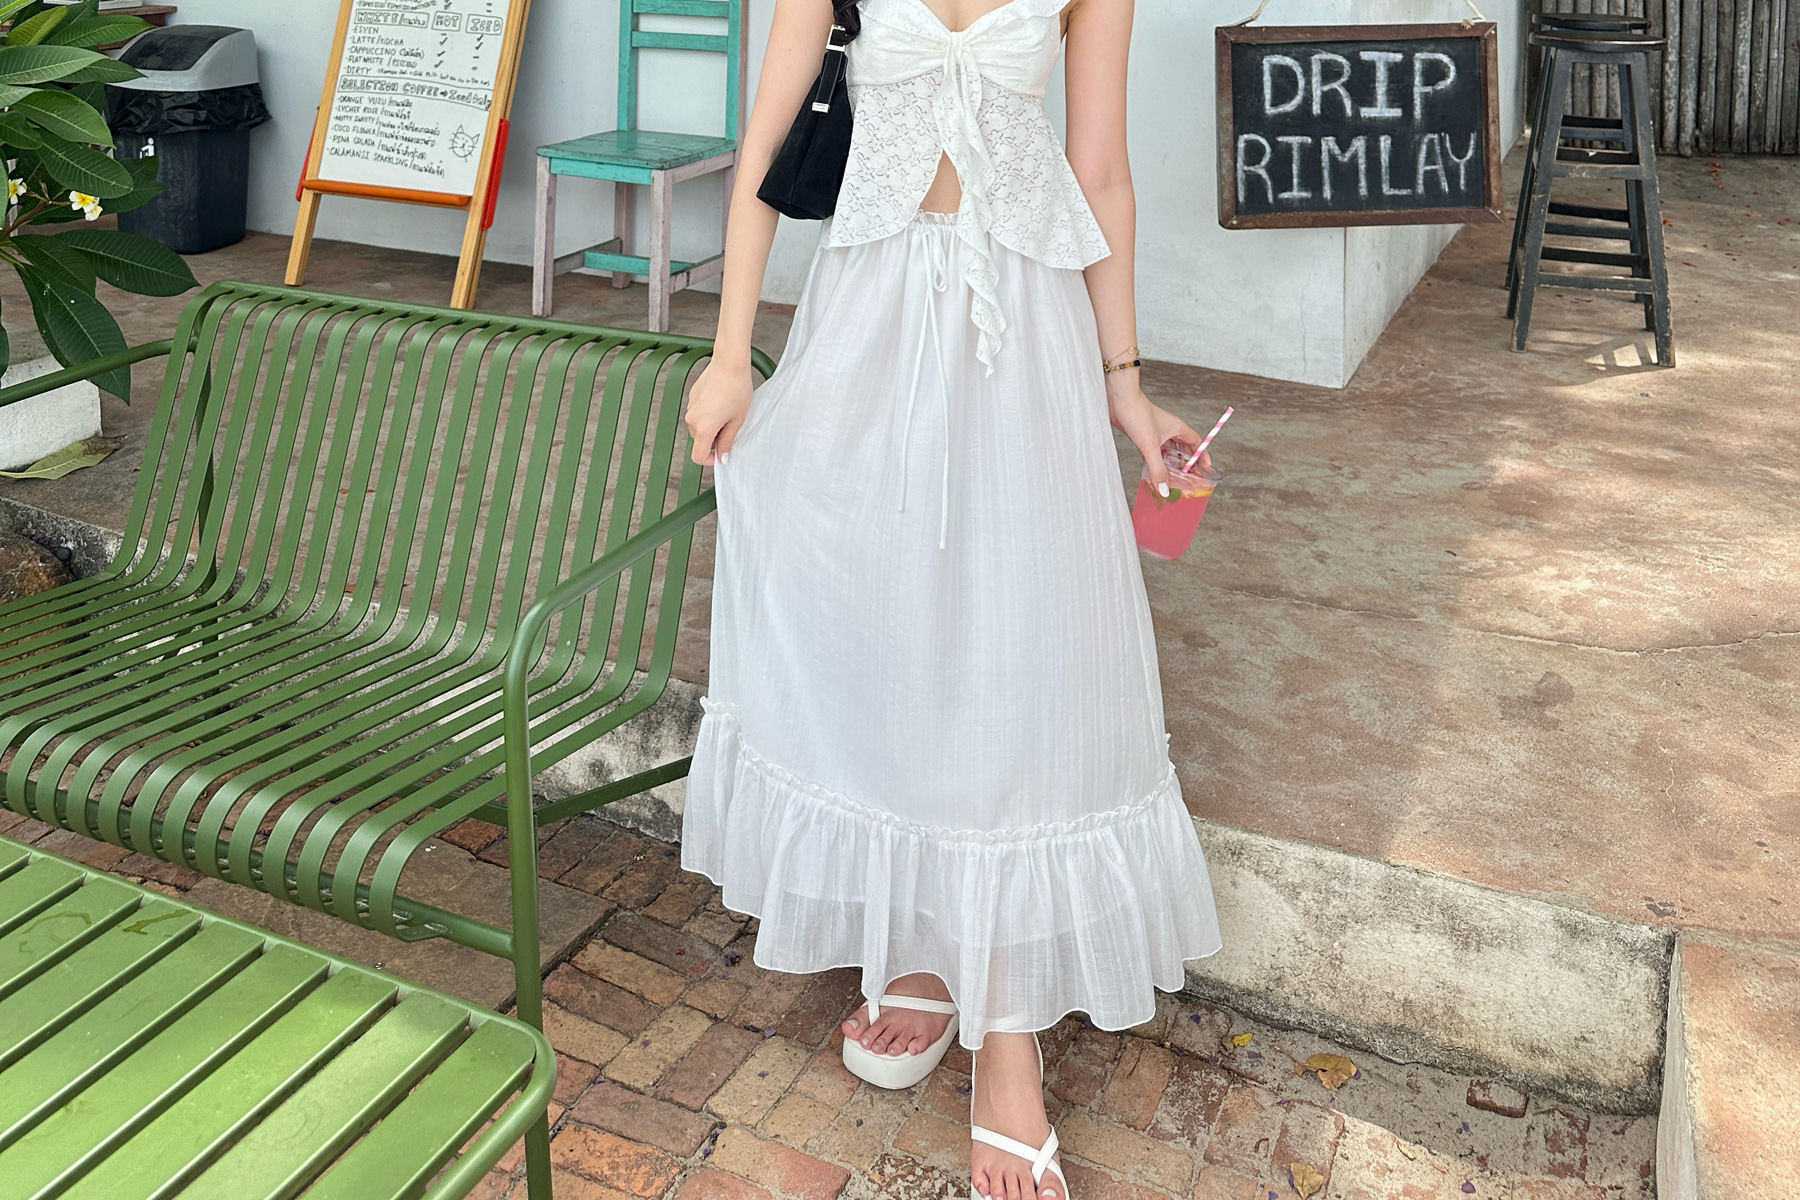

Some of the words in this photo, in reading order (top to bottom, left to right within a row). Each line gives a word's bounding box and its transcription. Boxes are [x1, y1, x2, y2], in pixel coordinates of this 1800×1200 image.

[436, 15, 459, 27] HOT
[470, 18, 501, 32] ICED
[350, 45, 397, 56] CAPPUCCINO
[346, 65, 372, 74] DIRTY
[341, 77, 399, 92] SELECTION
[402, 82, 440, 97] COFFEE
[1261, 49, 1457, 122] DRIP
[340, 95, 365, 104] ORANGE
[368, 97, 387, 105] YUZU
[337, 104, 361, 113] LYCHEE
[333, 124, 350, 132] COCO
[332, 134, 349, 143] PINA
[329, 146, 370, 160] CALAMANSI
[1235, 131, 1477, 204] RIMLAY
